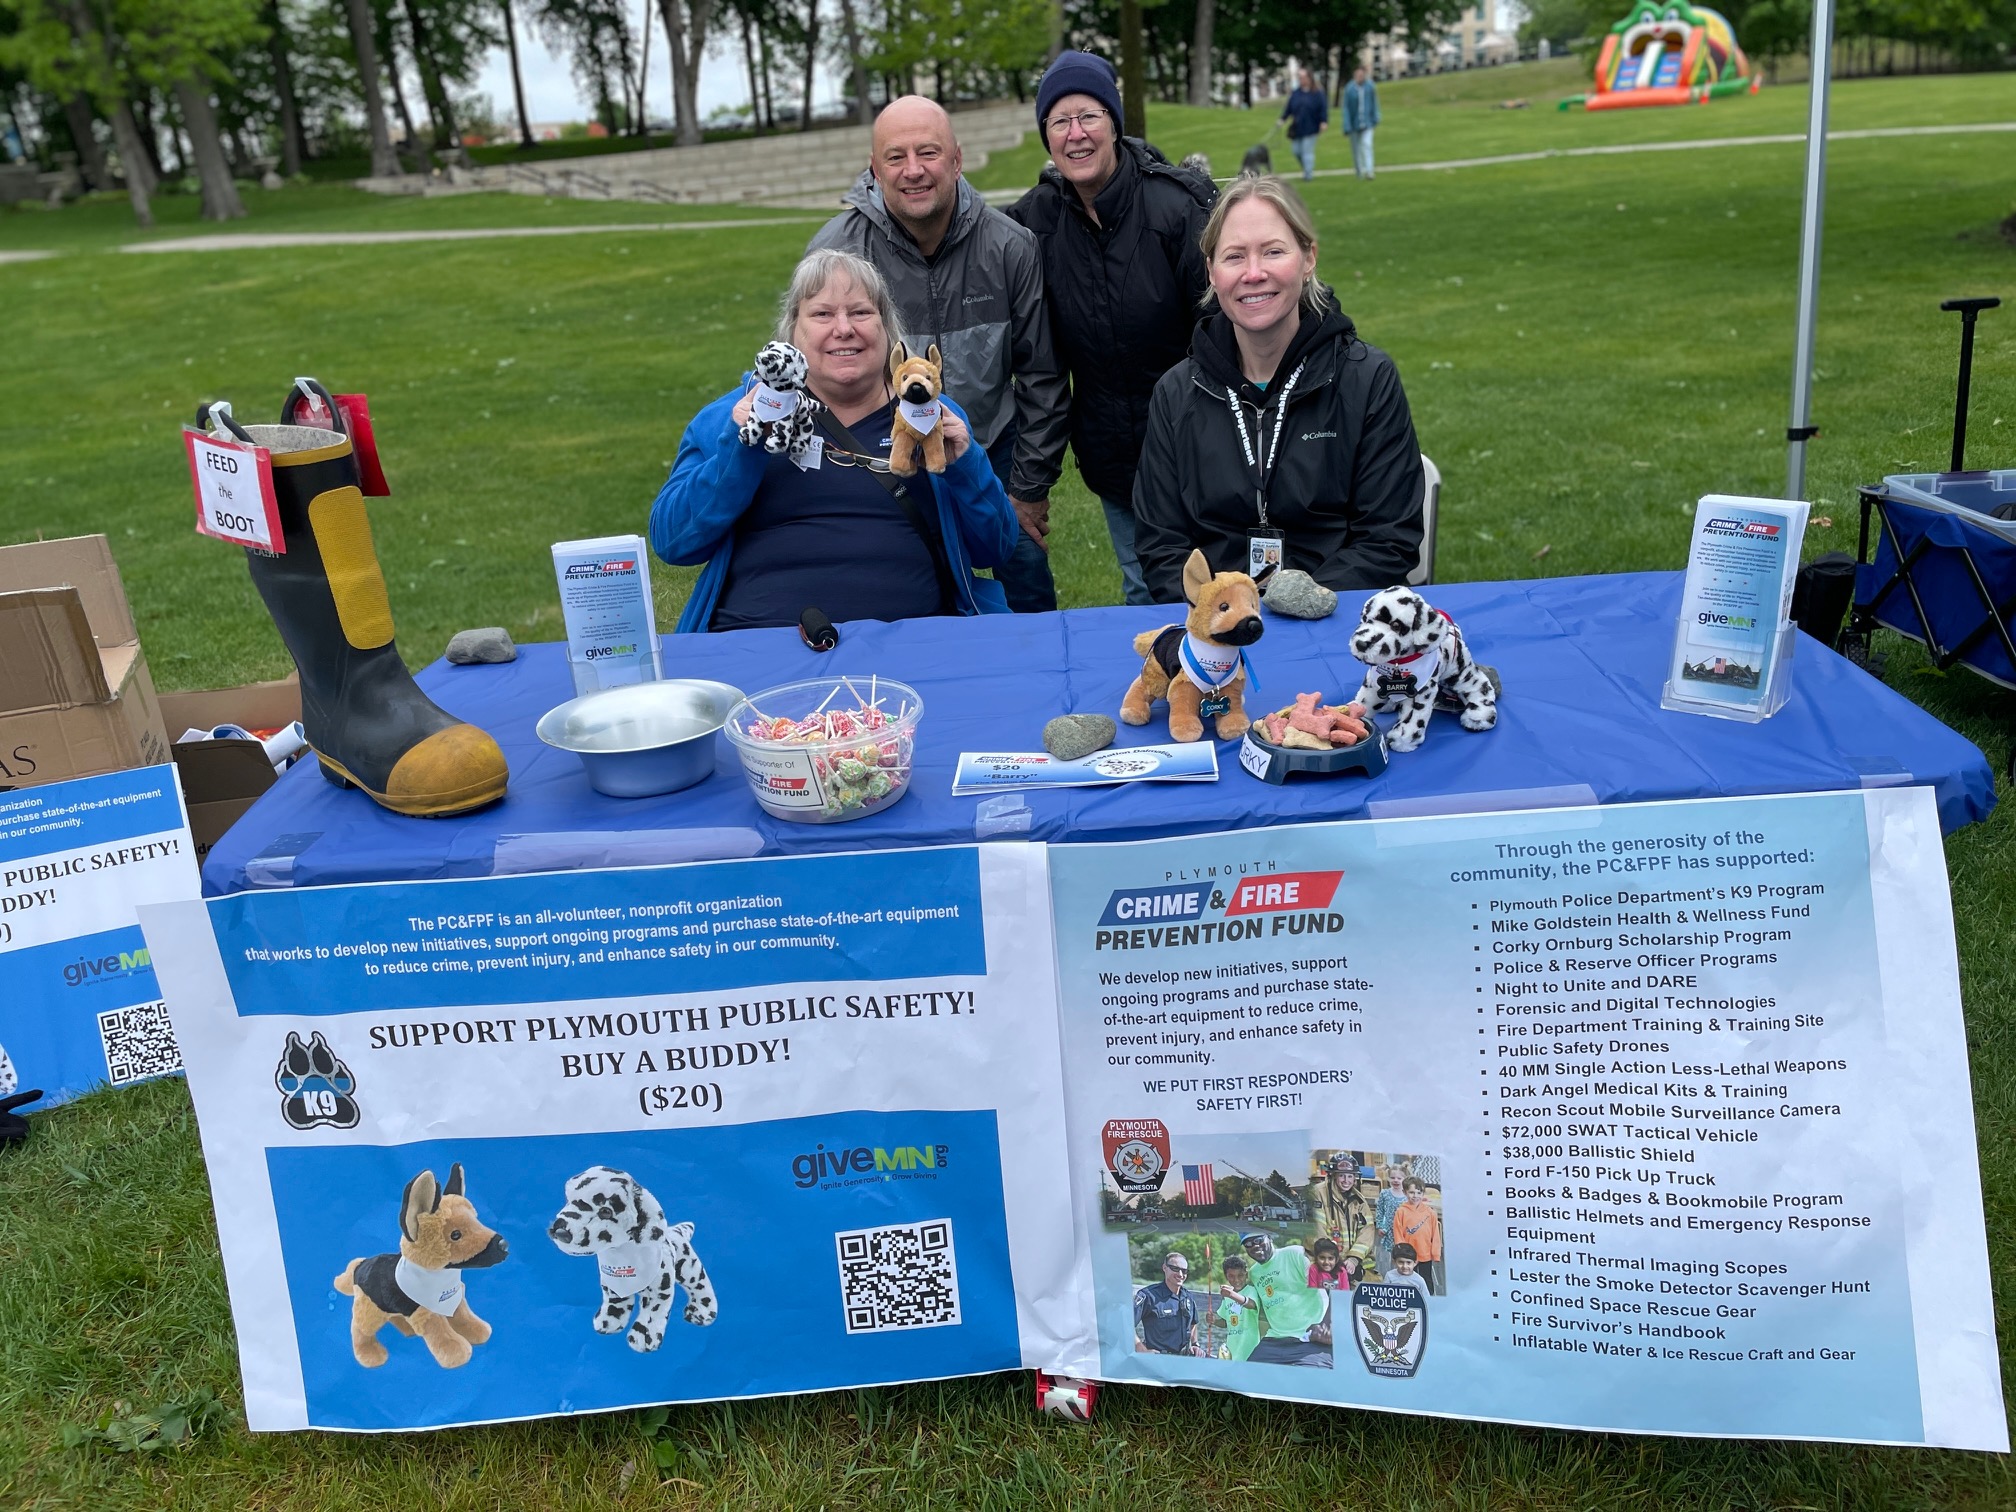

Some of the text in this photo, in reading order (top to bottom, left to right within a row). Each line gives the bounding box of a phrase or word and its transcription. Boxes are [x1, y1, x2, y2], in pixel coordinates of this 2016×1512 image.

[965, 294, 994, 303] Columbia
[1266, 362, 1304, 468] Plymouth Public Safety
[1235, 410, 1255, 466] Department
[1309, 430, 1336, 439] Columbia
[206, 452, 238, 474] FEED
[218, 486, 233, 500] the
[215, 510, 254, 534] BOOT
[1710, 521, 1737, 529] CRIME
[1703, 528, 1754, 539] PREVENTION
[565, 571, 613, 580] PREVENTION
[772, 780, 792, 788] FIRE
[41, 797, 112, 819] state-of-the-art
[112, 788, 162, 806] equipment
[10, 828, 27, 838] our
[28, 817, 85, 835] community.
[1494, 830, 1765, 859] Through the generosity of the
[3, 839, 180, 888] PUBLIC SAFETY!
[1165, 860, 1276, 882] PLYMOUTH
[1450, 848, 1815, 882] community, the PC&FPF has supported:
[1116, 882, 1300, 919] CRIME & FIRE
[1489, 896, 1558, 915] Plymouth
[1562, 893, 1613, 908] Police
[1730, 885, 1753, 899] K9
[1757, 884, 1825, 900] Program
[407, 894, 783, 932] The PC&FPF is an all-volunteer, nonprofit organization
[1491, 903, 1811, 933] Mike Goldstein Health & Wellness Fund
[1095, 913, 1345, 950] PREVENTION FUND
[1492, 930, 1792, 956] Corky Ornburg Scholarship Program
[1098, 955, 1348, 986] We develop new initiatives, support
[1493, 953, 1778, 975] Police & Reserve Officer Programs
[369, 990, 975, 1050] SUPPORT PLYMOUTH PUBLIC SAFETY!
[560, 1037, 791, 1078] BUY A BUDDY!
[1142, 1080, 1167, 1094] WE
[1170, 1078, 1199, 1093] PUT
[1202, 1076, 1245, 1092] FIRST
[303, 1091, 338, 1117] K9
[639, 1083, 723, 1116] ($20)
[1196, 1092, 1303, 1112] SAFETY FIRST!
[1108, 1130, 1163, 1138] FIRE-RESCUE
[1110, 1121, 1158, 1130] PLYMOUTH
[1501, 1123, 1759, 1143] $72,000 SWAT Tactical Vehicle
[1502, 1144, 1695, 1163] $38,000 Ballistic Shield
[820, 1182, 842, 1191] Ignite
[844, 1176, 884, 1187] Generosity
[914, 1172, 937, 1180] Giving
[1362, 1286, 1414, 1298] PLYMOUTH
[1509, 1267, 1871, 1299] Lester the Smoke Detector Scavenger Hunt
[1371, 1297, 1407, 1308] POLICE
[1511, 1311, 1543, 1327] Fire
[1638, 1322, 1726, 1340] Handbook
[1376, 1367, 1408, 1376] MINNESOTA
